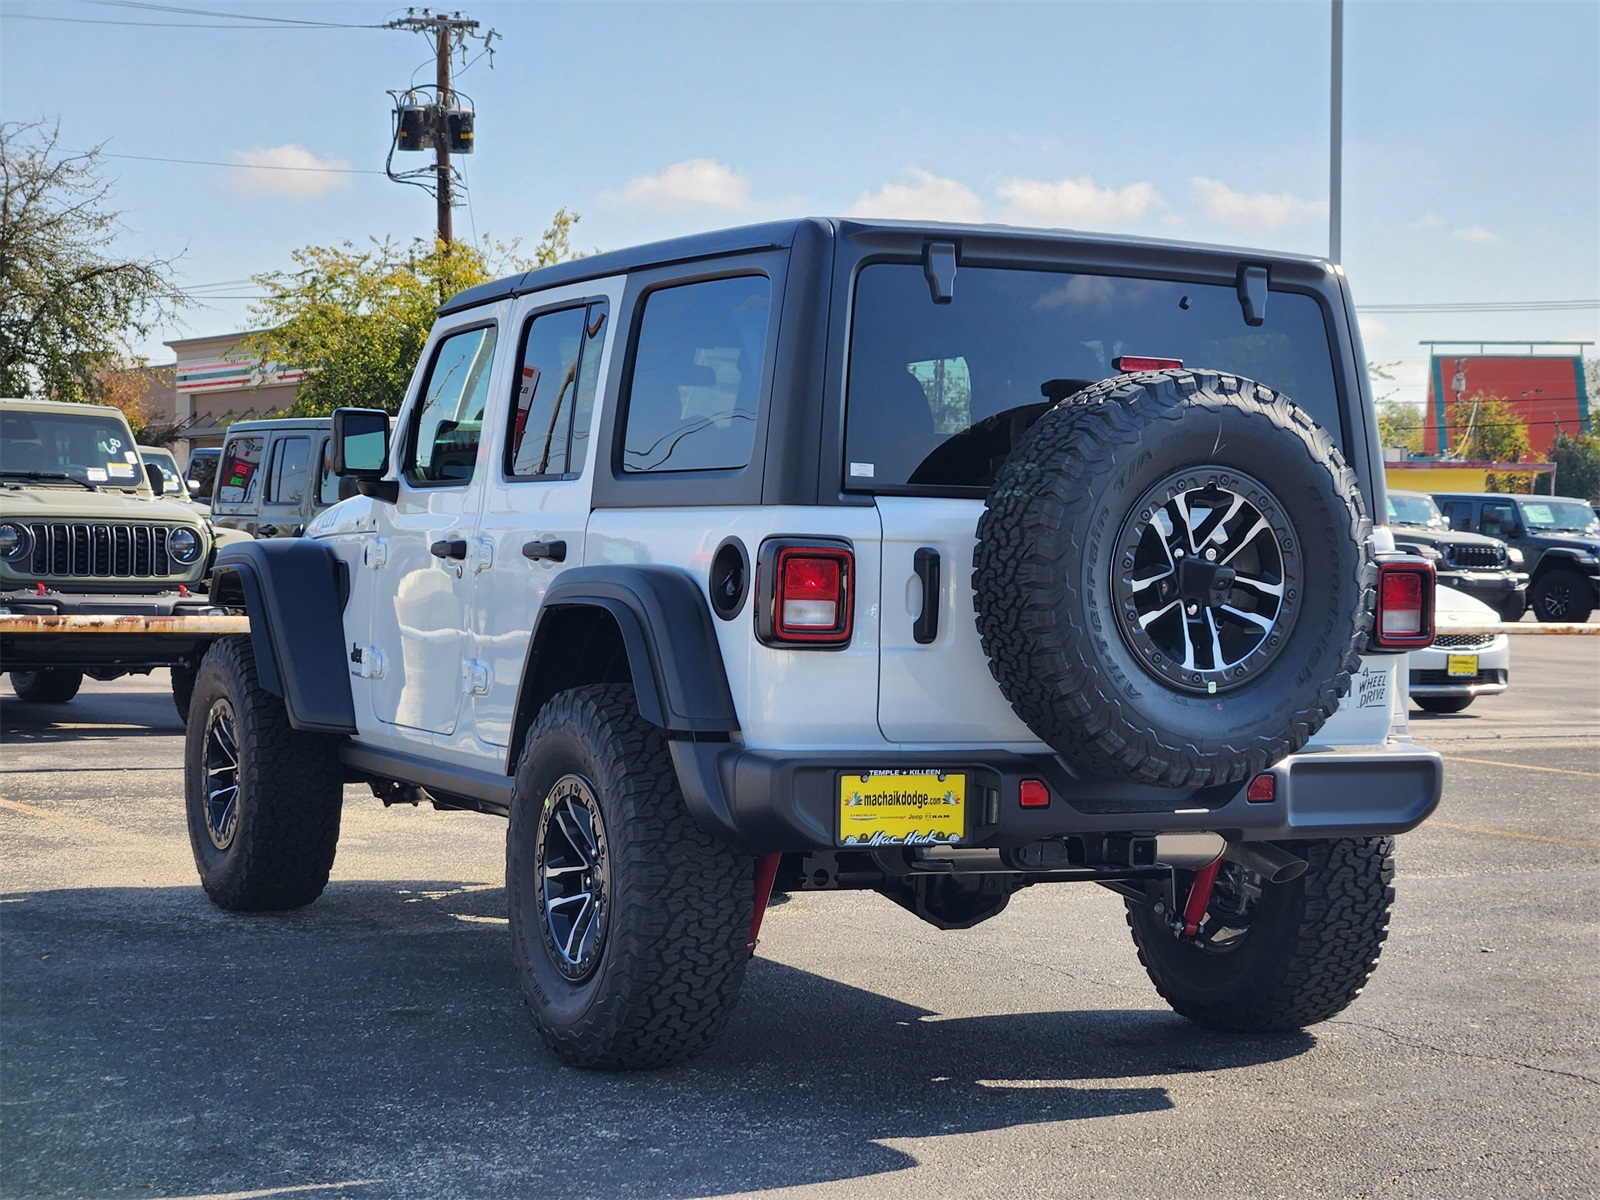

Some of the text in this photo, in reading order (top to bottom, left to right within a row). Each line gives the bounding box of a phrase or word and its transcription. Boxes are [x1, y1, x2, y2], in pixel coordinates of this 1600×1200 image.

[1362, 667, 1369, 678] 4
[1359, 675, 1386, 693] WHEEL
[1359, 688, 1386, 709] DRIVE
[864, 790, 941, 809] machaikdodge.com
[870, 830, 937, 847] Mac Haik
